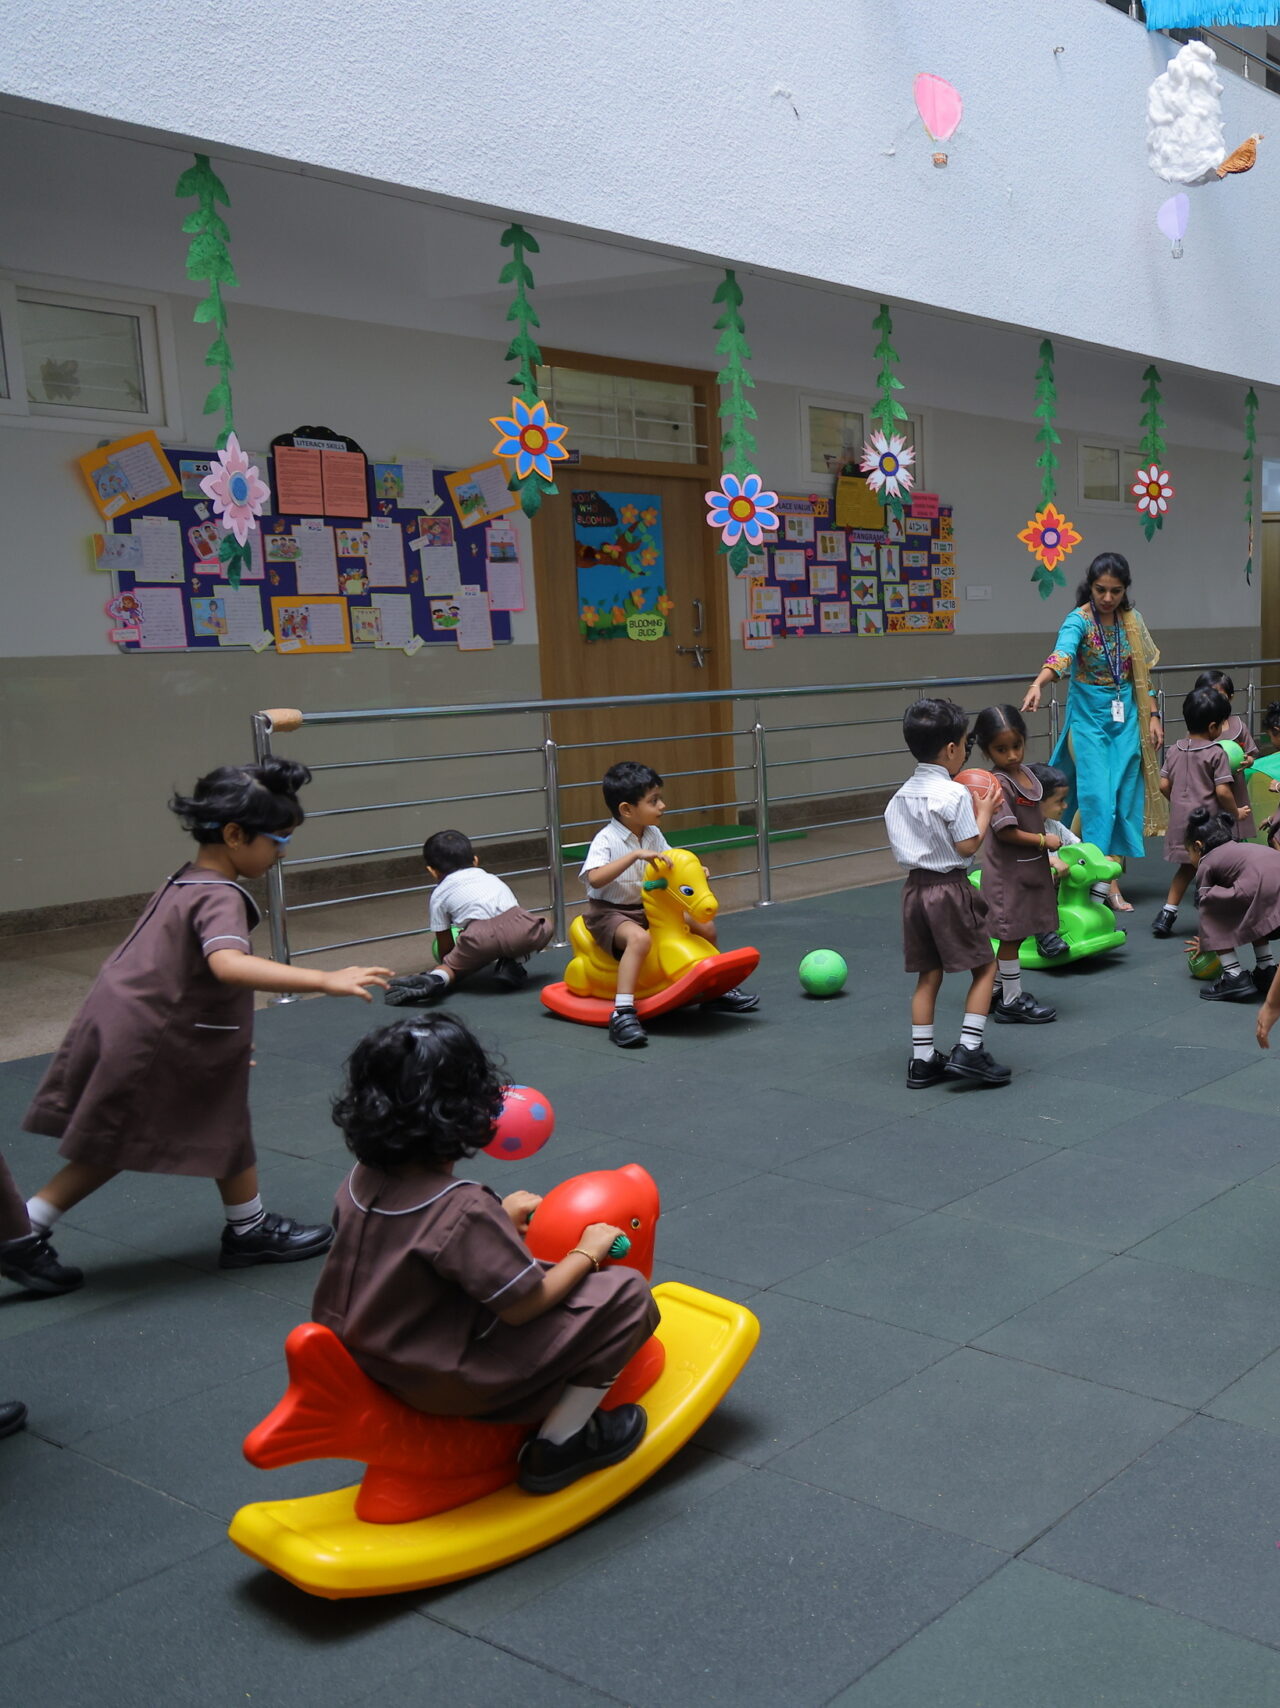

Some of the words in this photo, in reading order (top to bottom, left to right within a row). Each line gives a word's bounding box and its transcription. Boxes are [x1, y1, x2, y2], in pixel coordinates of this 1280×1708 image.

[296, 440, 325, 448] LITERACY
[326, 442, 345, 450] SKILLS
[195, 464, 211, 472] ZO
[629, 618, 663, 629] BLOOMING
[637, 628, 657, 637] BUDS
